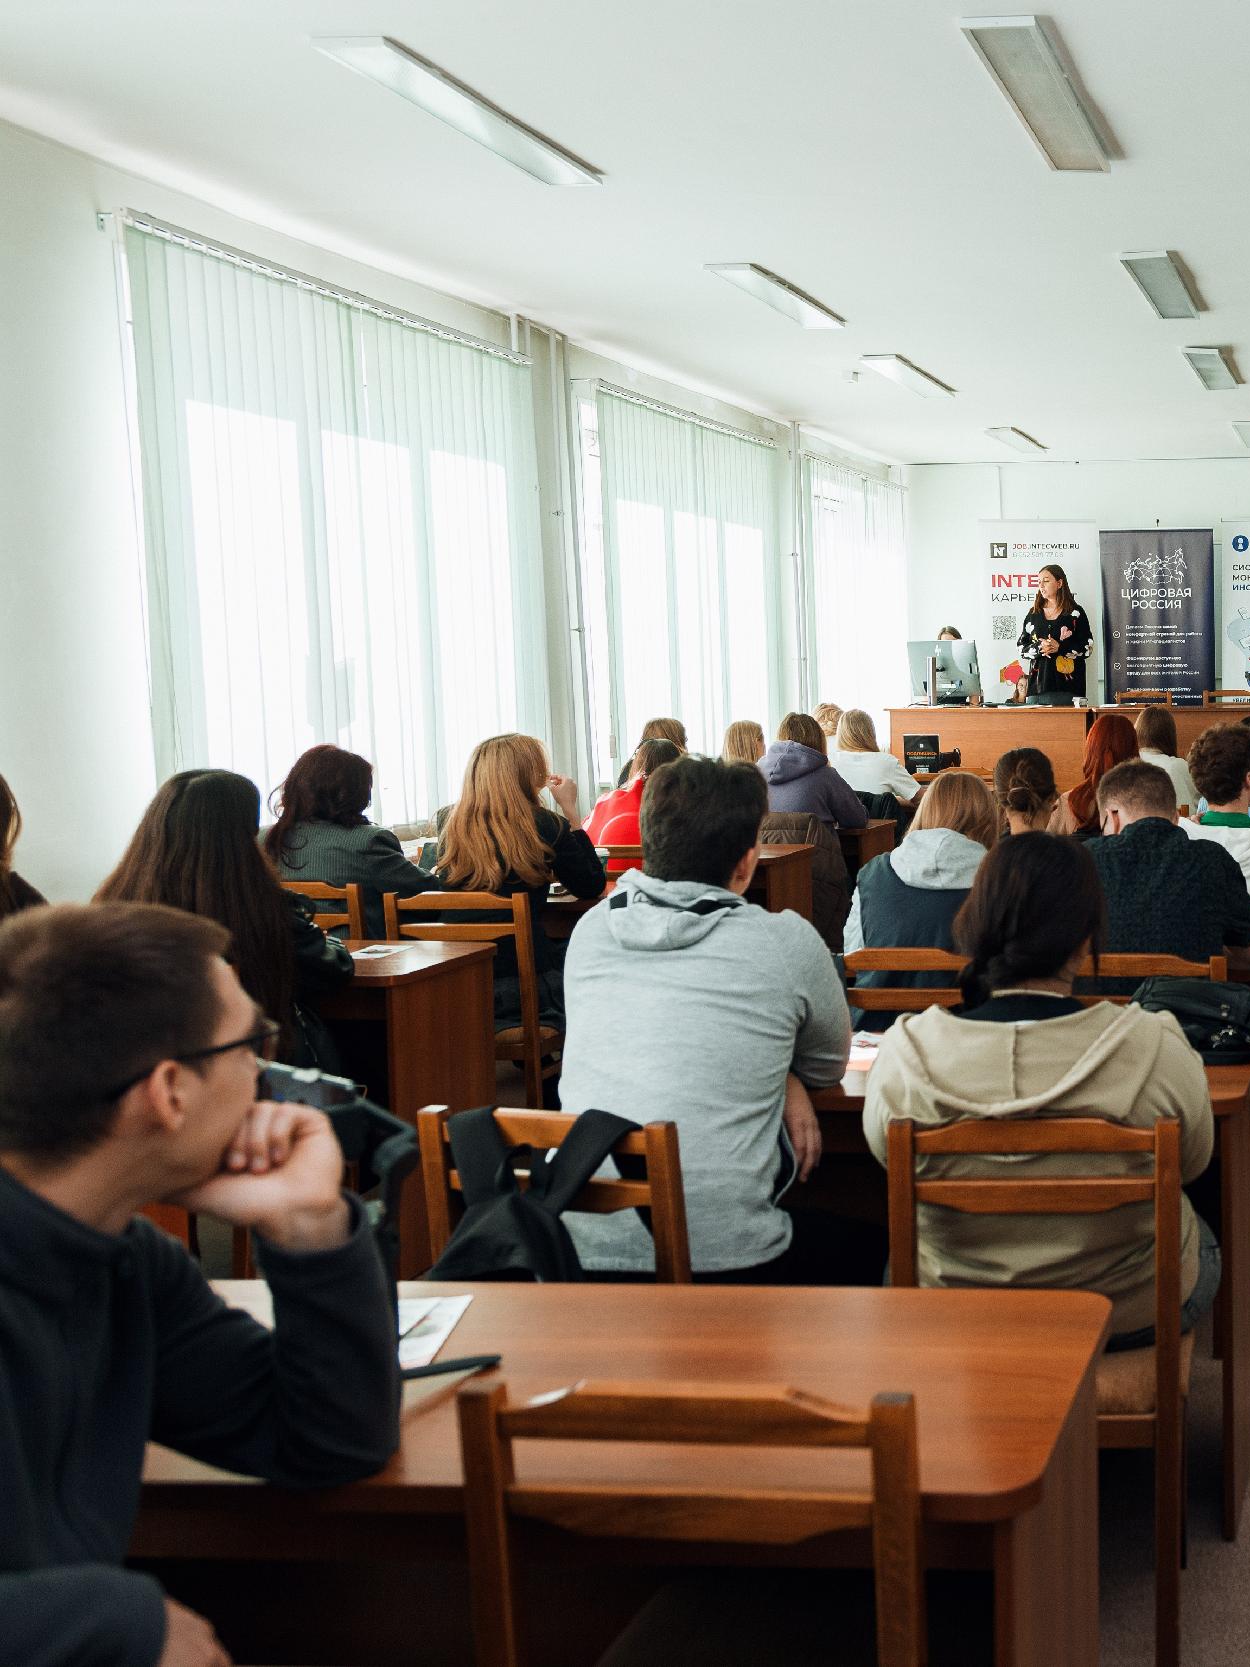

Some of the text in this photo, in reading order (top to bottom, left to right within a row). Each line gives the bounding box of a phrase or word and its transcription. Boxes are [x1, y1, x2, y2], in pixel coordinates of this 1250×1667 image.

[992, 574, 1039, 588] INTE
[992, 593, 1036, 602] КАРЬЕ
[1121, 588, 1192, 600] ЦИФРОВАЯ
[1131, 600, 1182, 609] РОССИЯ
